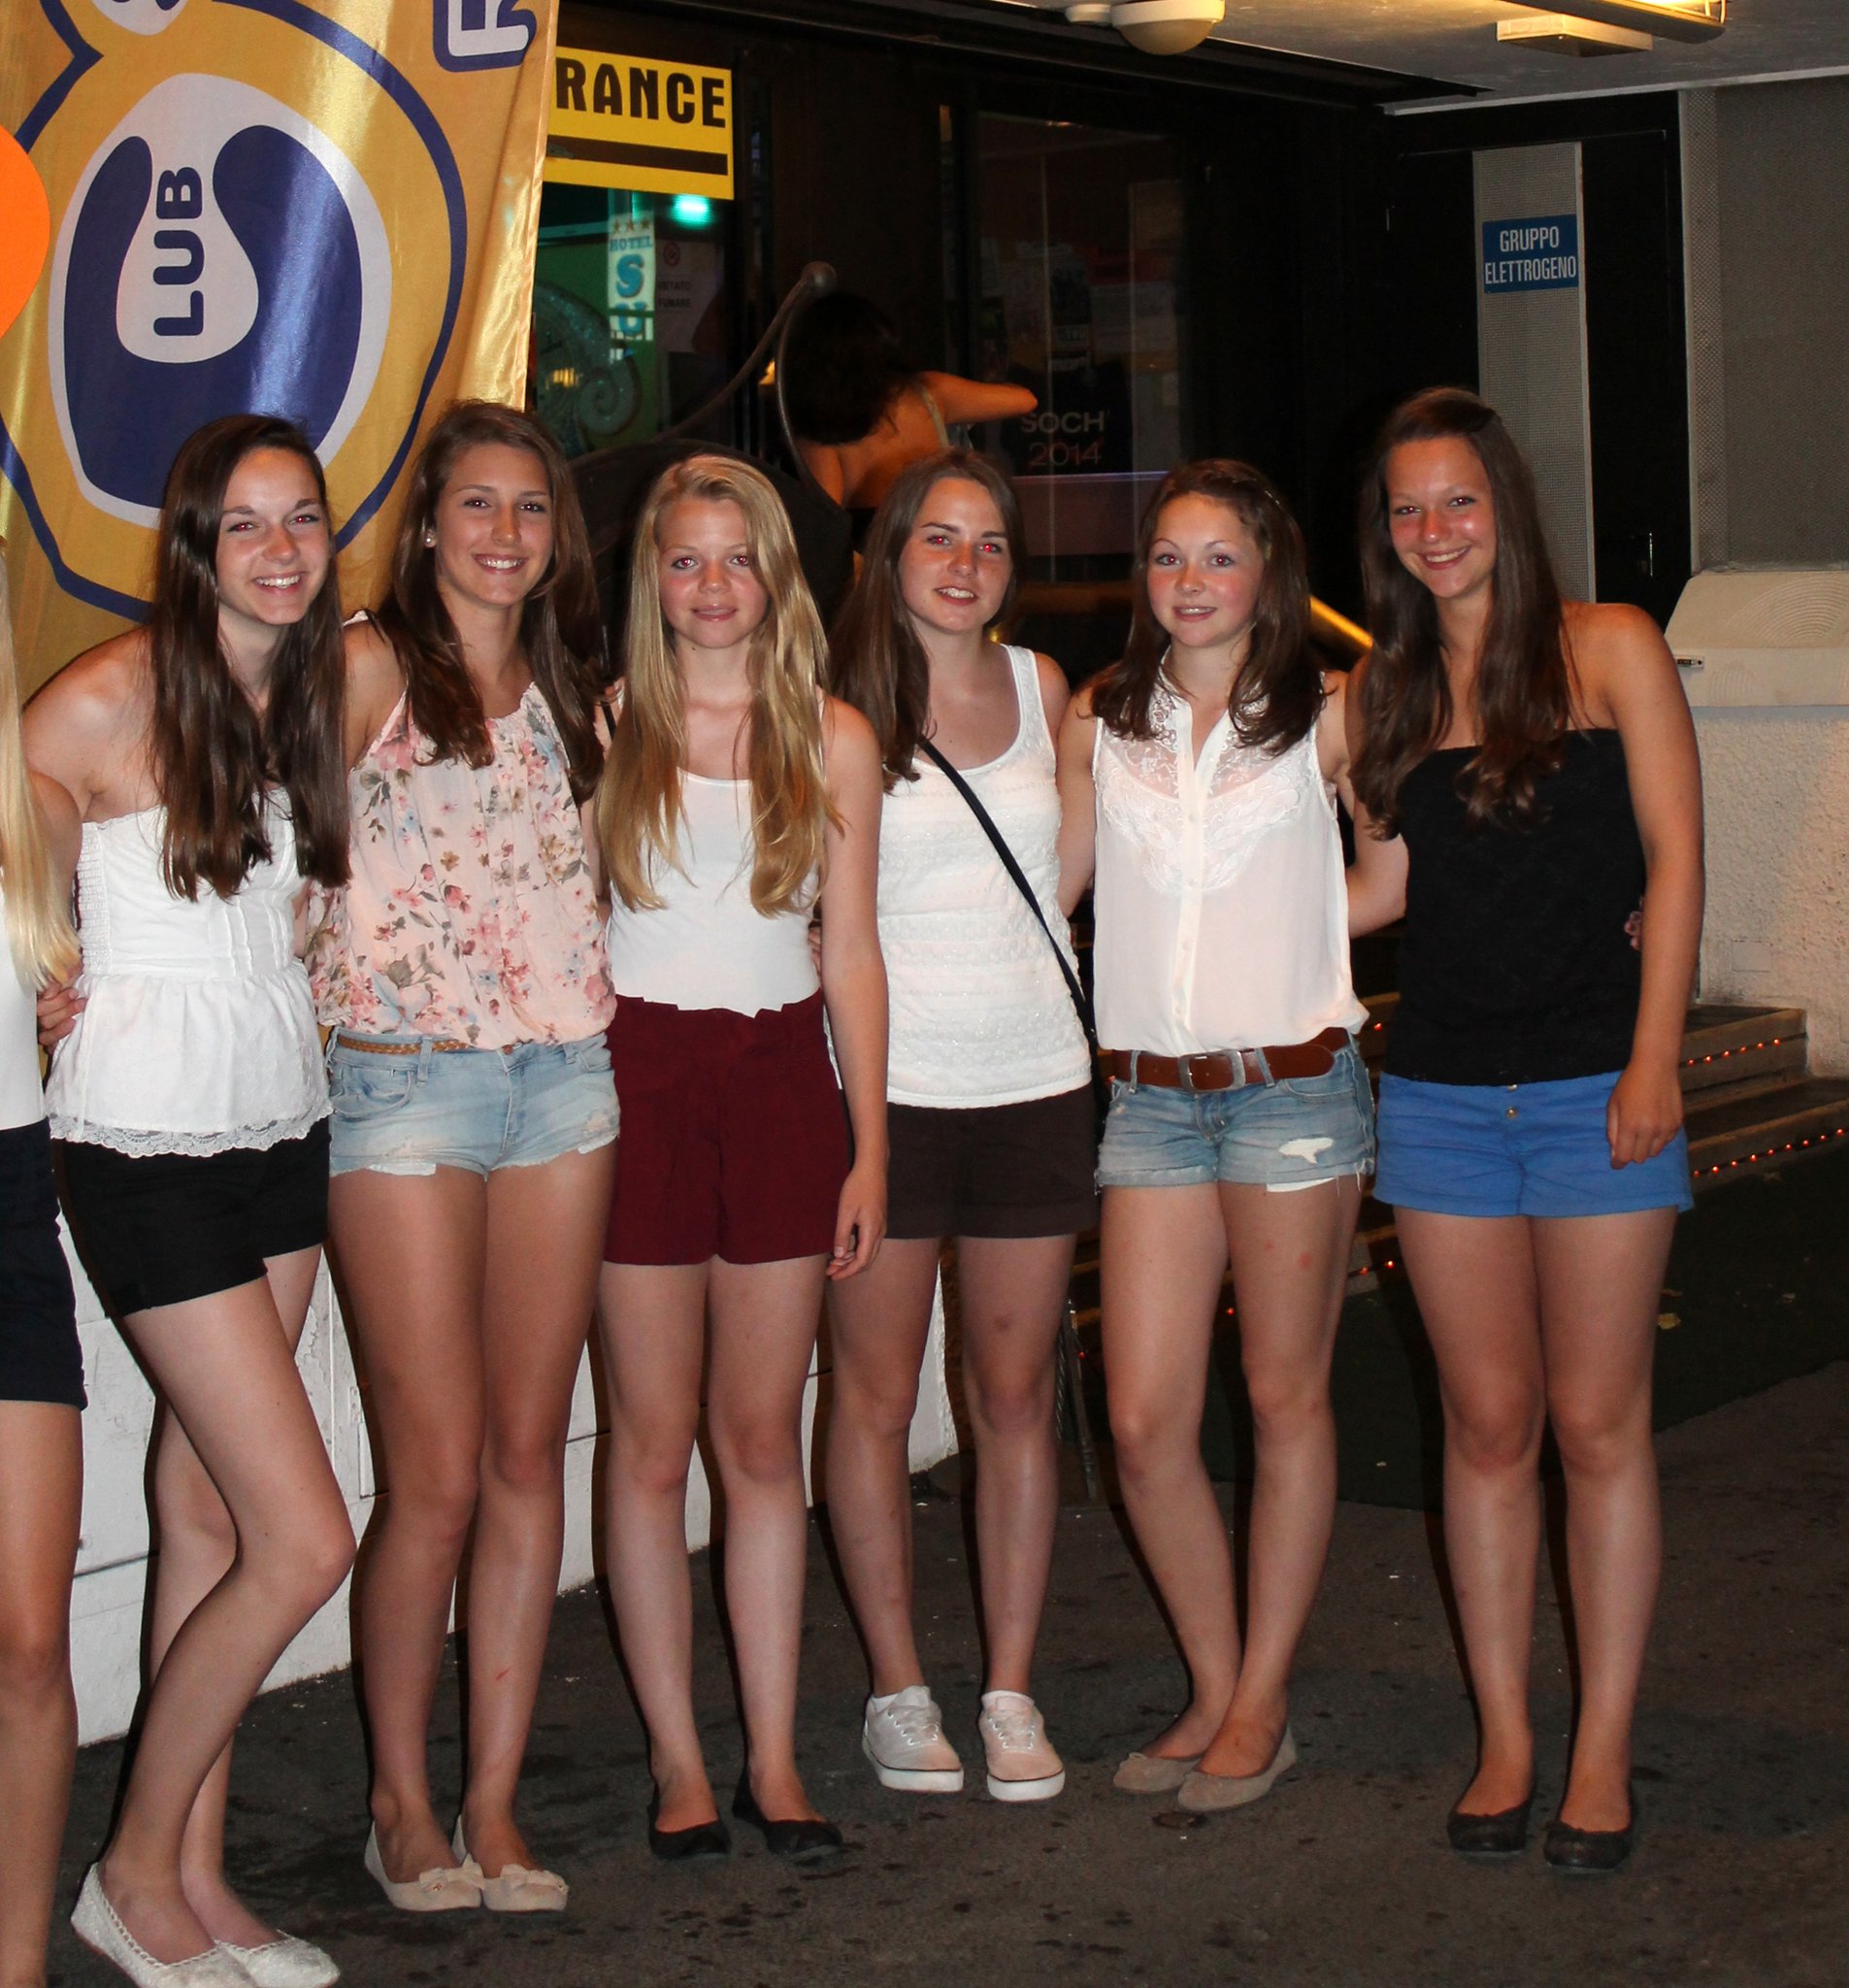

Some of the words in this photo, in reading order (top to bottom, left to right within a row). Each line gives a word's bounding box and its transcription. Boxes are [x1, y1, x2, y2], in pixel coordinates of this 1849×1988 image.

[555, 56, 726, 128] RANCE
[610, 236, 653, 251] HOTEL
[1500, 226, 1560, 252] GRUPPO
[1484, 256, 1576, 284] ELETTROGENO
[1028, 441, 1103, 466] 2014
